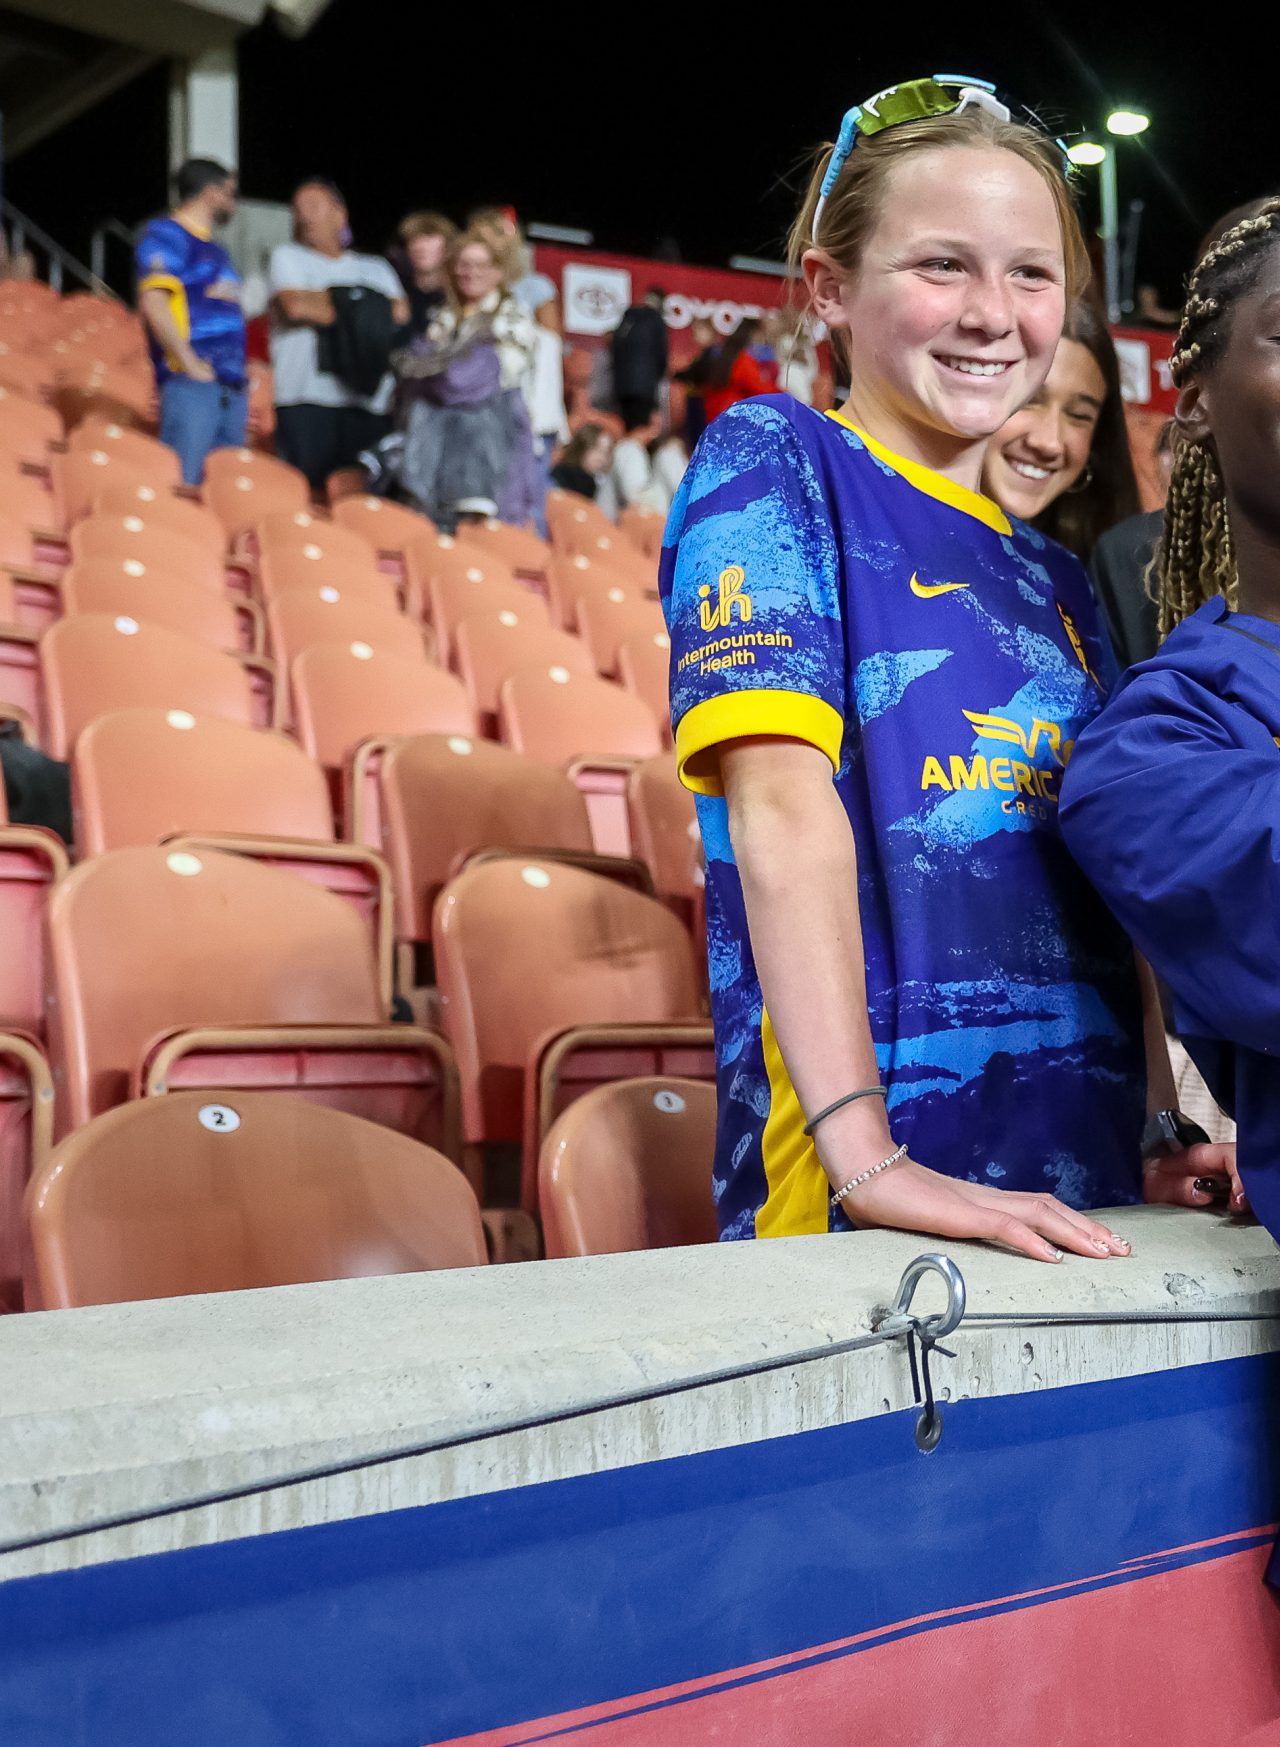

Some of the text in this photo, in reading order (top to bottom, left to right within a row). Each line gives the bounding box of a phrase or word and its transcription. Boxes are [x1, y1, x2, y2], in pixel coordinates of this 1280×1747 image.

[677, 631, 793, 673] Intermountain
[700, 649, 756, 676] Health
[920, 755, 1060, 802] AMERIC
[212, 1111, 226, 1126] 2
